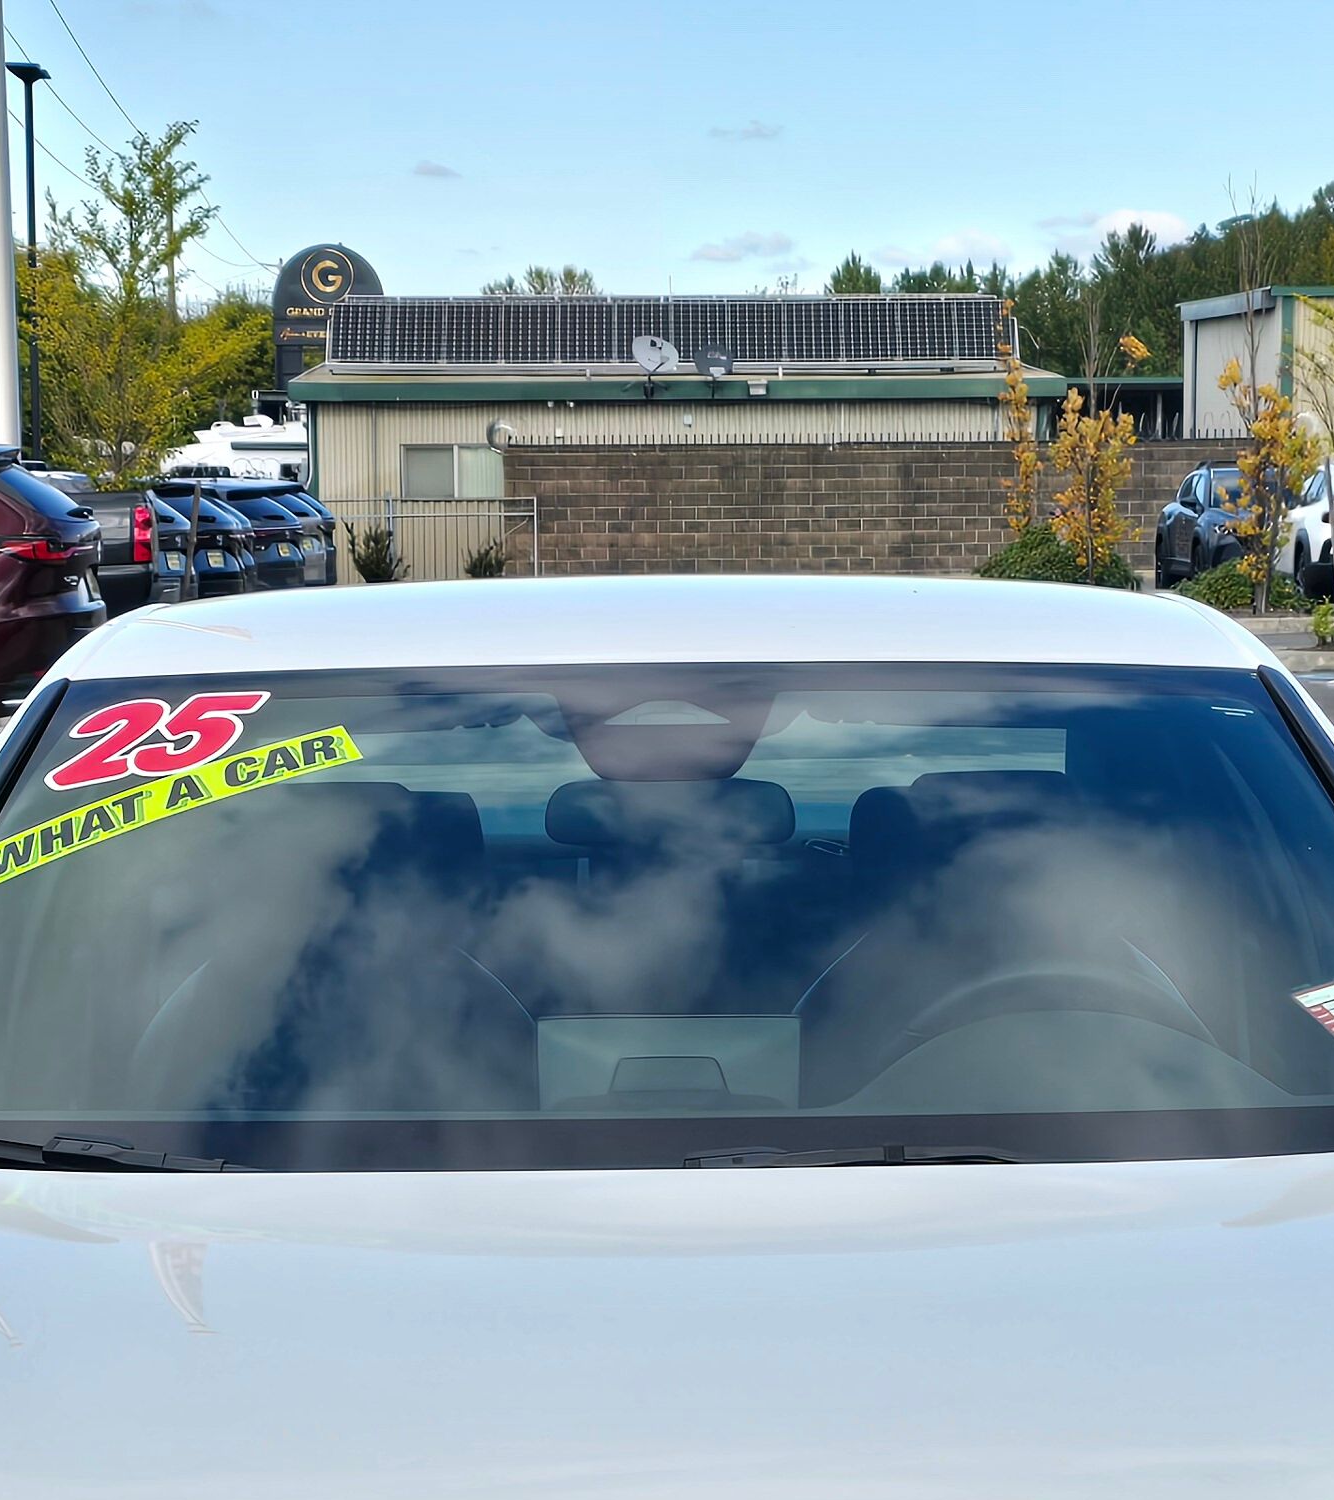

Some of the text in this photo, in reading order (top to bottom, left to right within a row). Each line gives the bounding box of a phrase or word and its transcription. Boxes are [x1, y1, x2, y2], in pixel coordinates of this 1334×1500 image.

[312, 260, 342, 292] G
[286, 307, 325, 316] GRAND
[44, 690, 271, 791] 25
[165, 775, 211, 810] A
[225, 735, 347, 788] CAR
